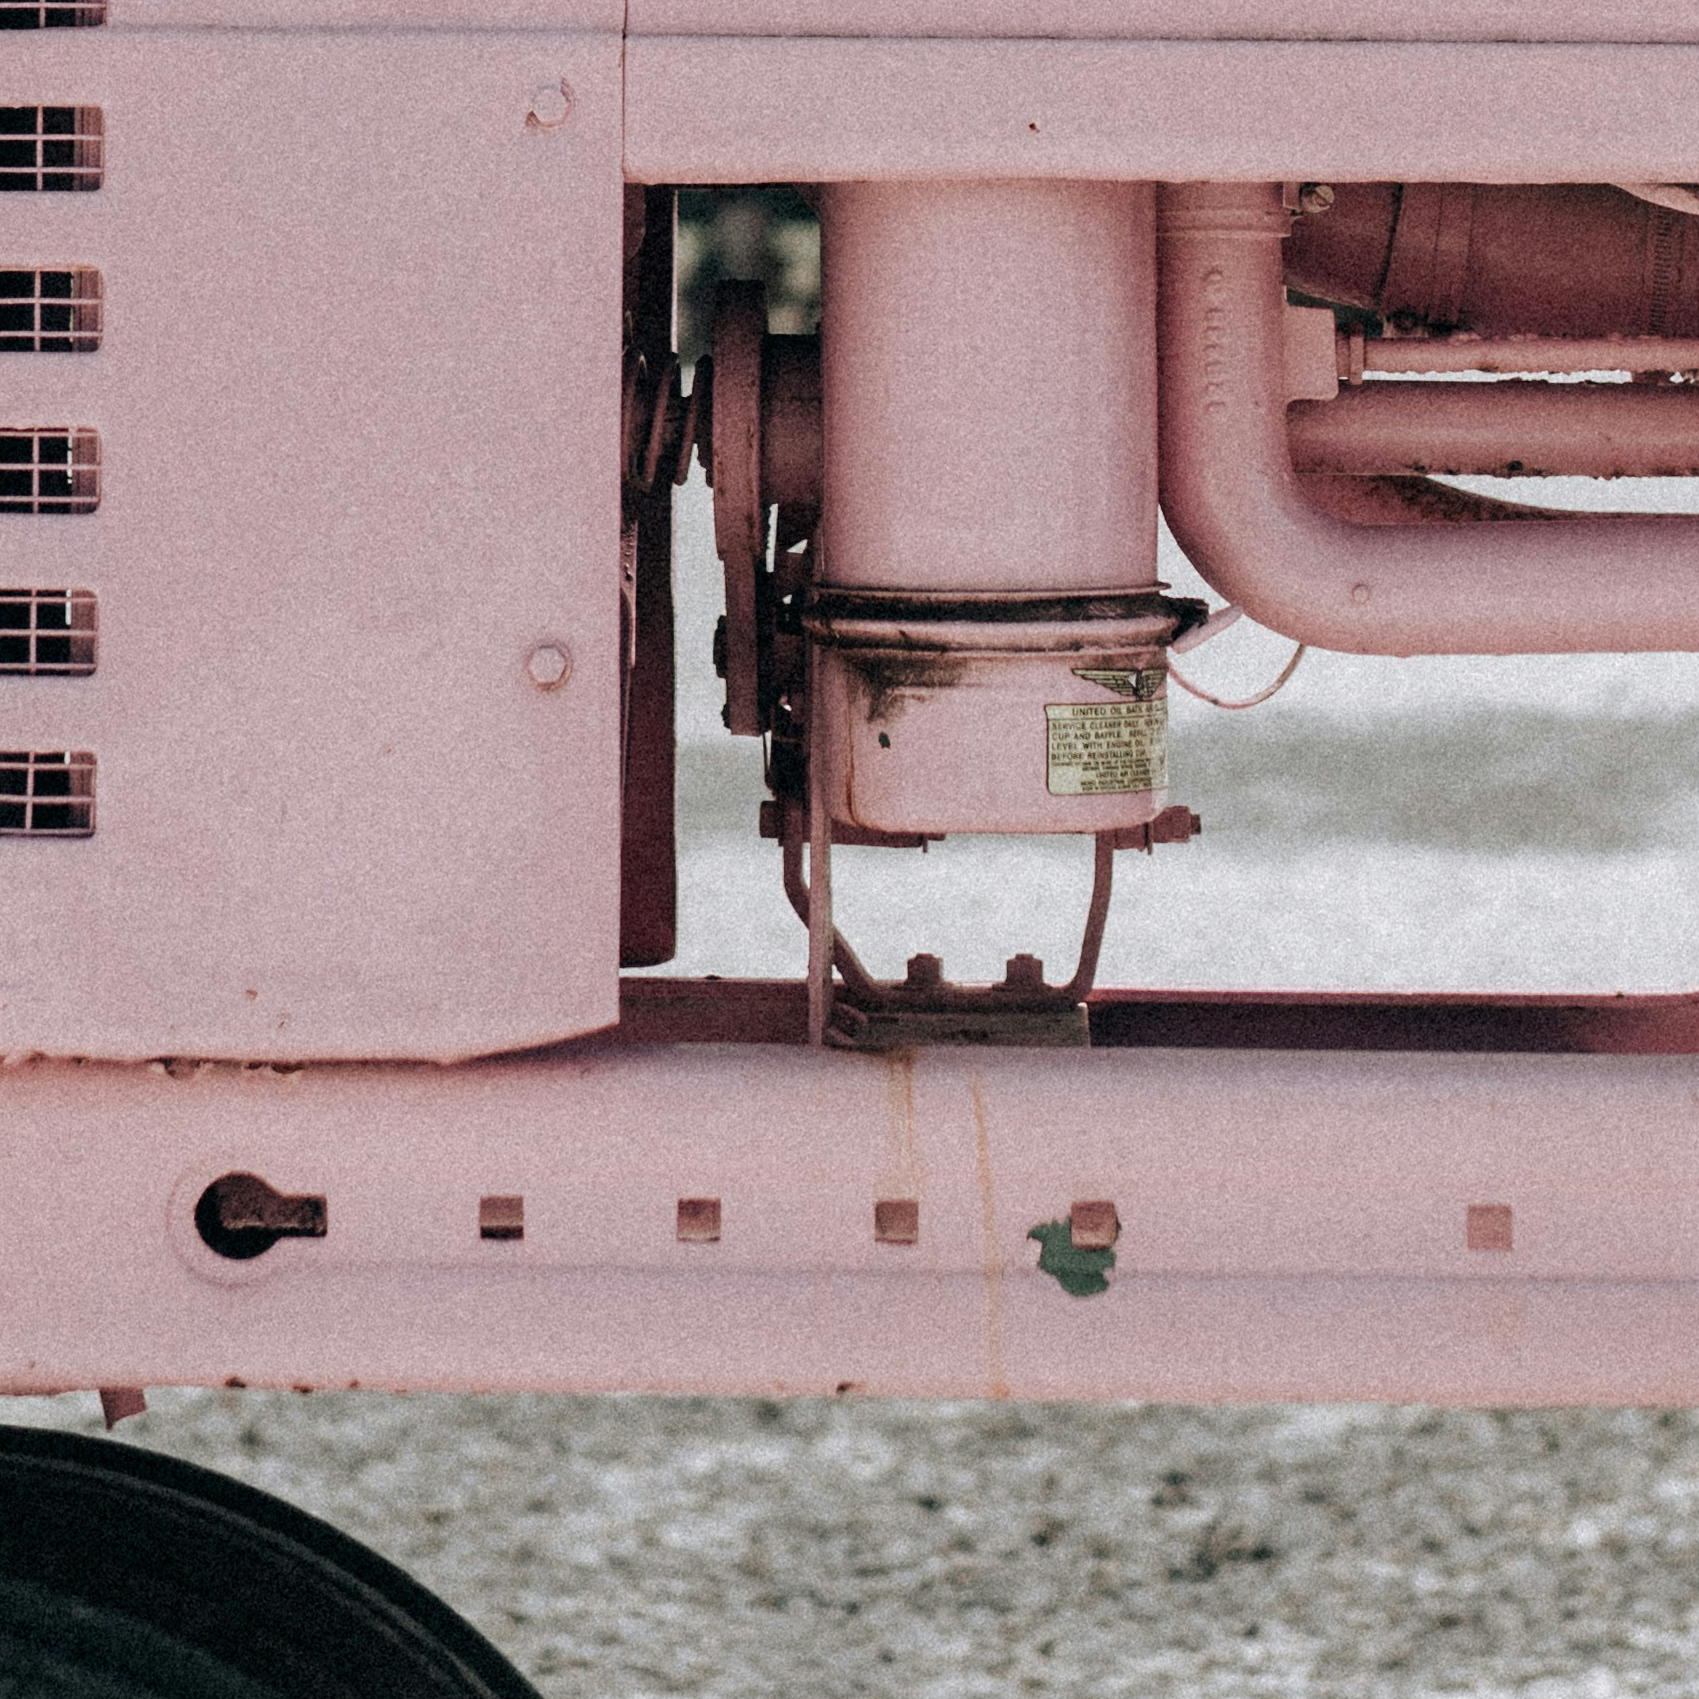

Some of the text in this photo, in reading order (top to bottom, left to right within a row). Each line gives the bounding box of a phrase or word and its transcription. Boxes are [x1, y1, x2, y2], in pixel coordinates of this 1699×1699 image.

[1071, 706, 1106, 717] UNITED
[1110, 705, 1122, 715] OIL
[1051, 721, 1086, 731] SERVICE
[1089, 720, 1121, 730] CLEANER
[1051, 732, 1070, 741] CUP
[1074, 731, 1091, 740] AND
[1051, 741, 1077, 751] LEVEL
[1082, 741, 1103, 750] WITH
[1106, 739, 1132, 749] ENGINE
[1051, 751, 1083, 761] BEFORE
